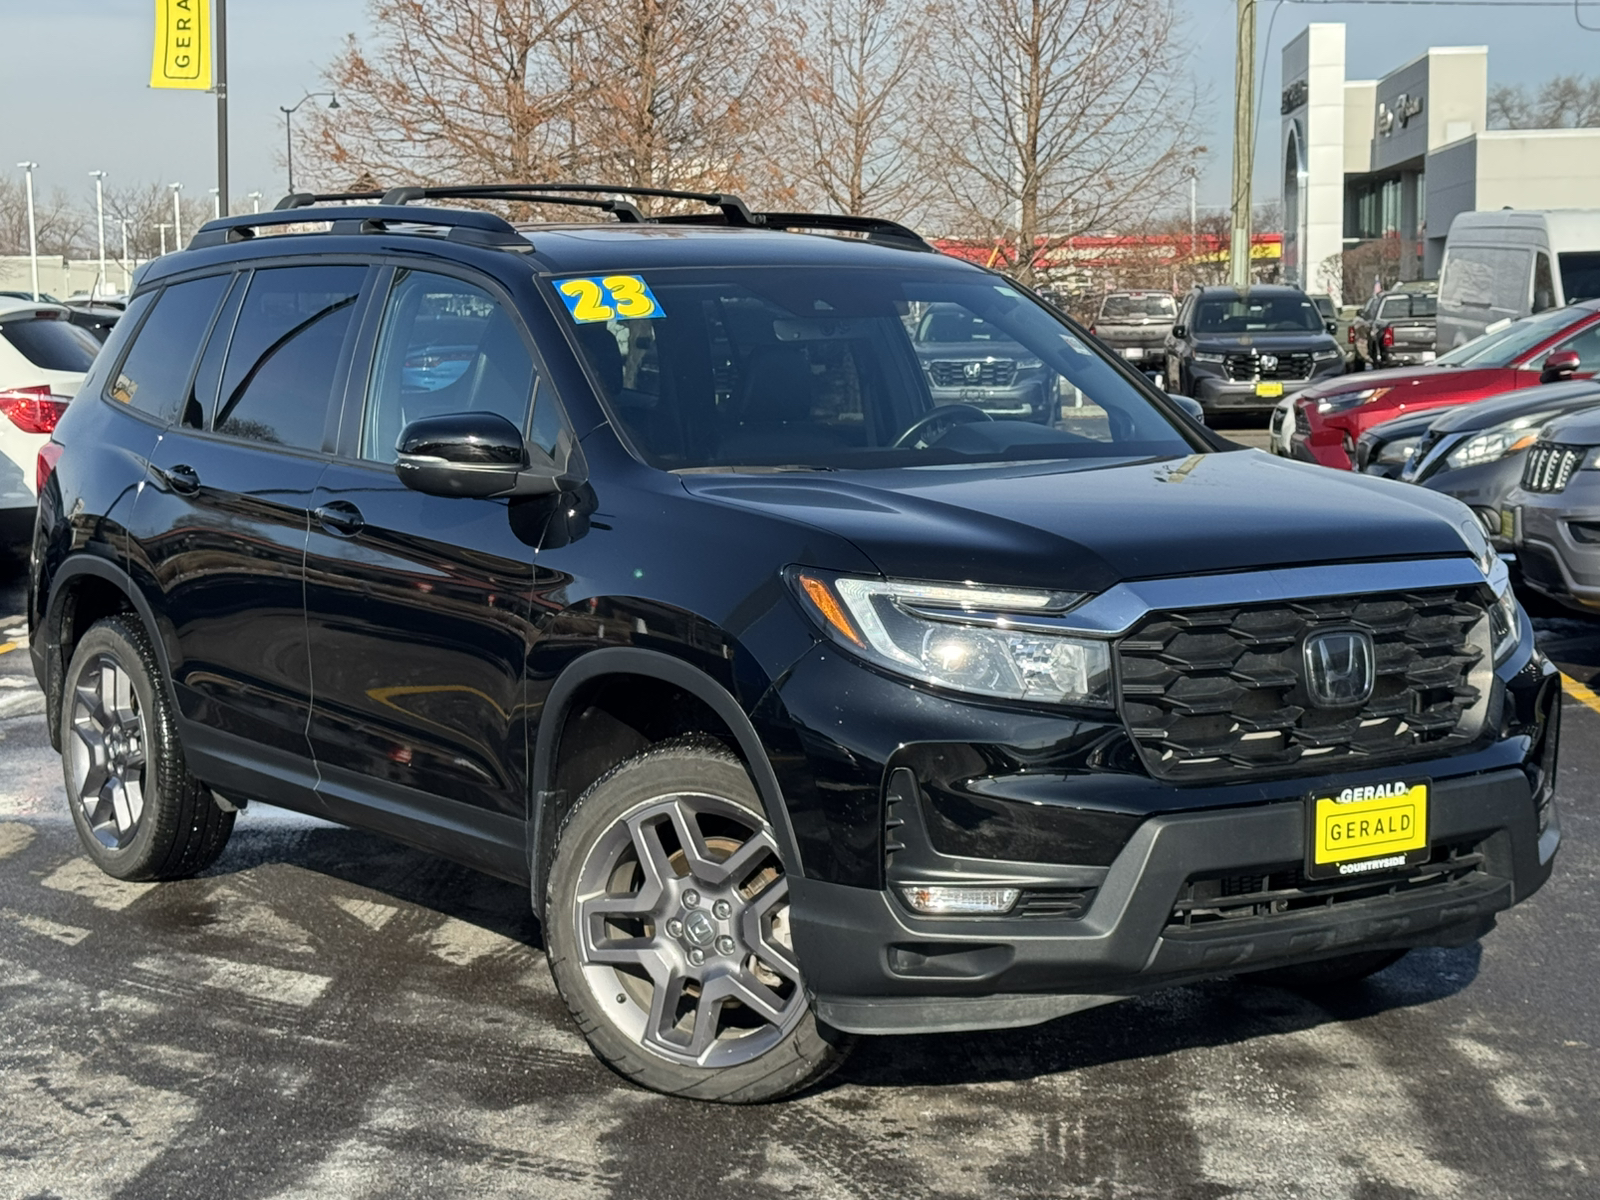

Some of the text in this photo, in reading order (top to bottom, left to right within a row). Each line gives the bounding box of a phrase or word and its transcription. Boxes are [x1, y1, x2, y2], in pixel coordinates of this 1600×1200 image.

[560, 275, 655, 320] 23
[1340, 781, 1406, 803] GERALD
[1330, 814, 1411, 841] GERALD
[1339, 855, 1406, 875] COUNTRYSIDE
